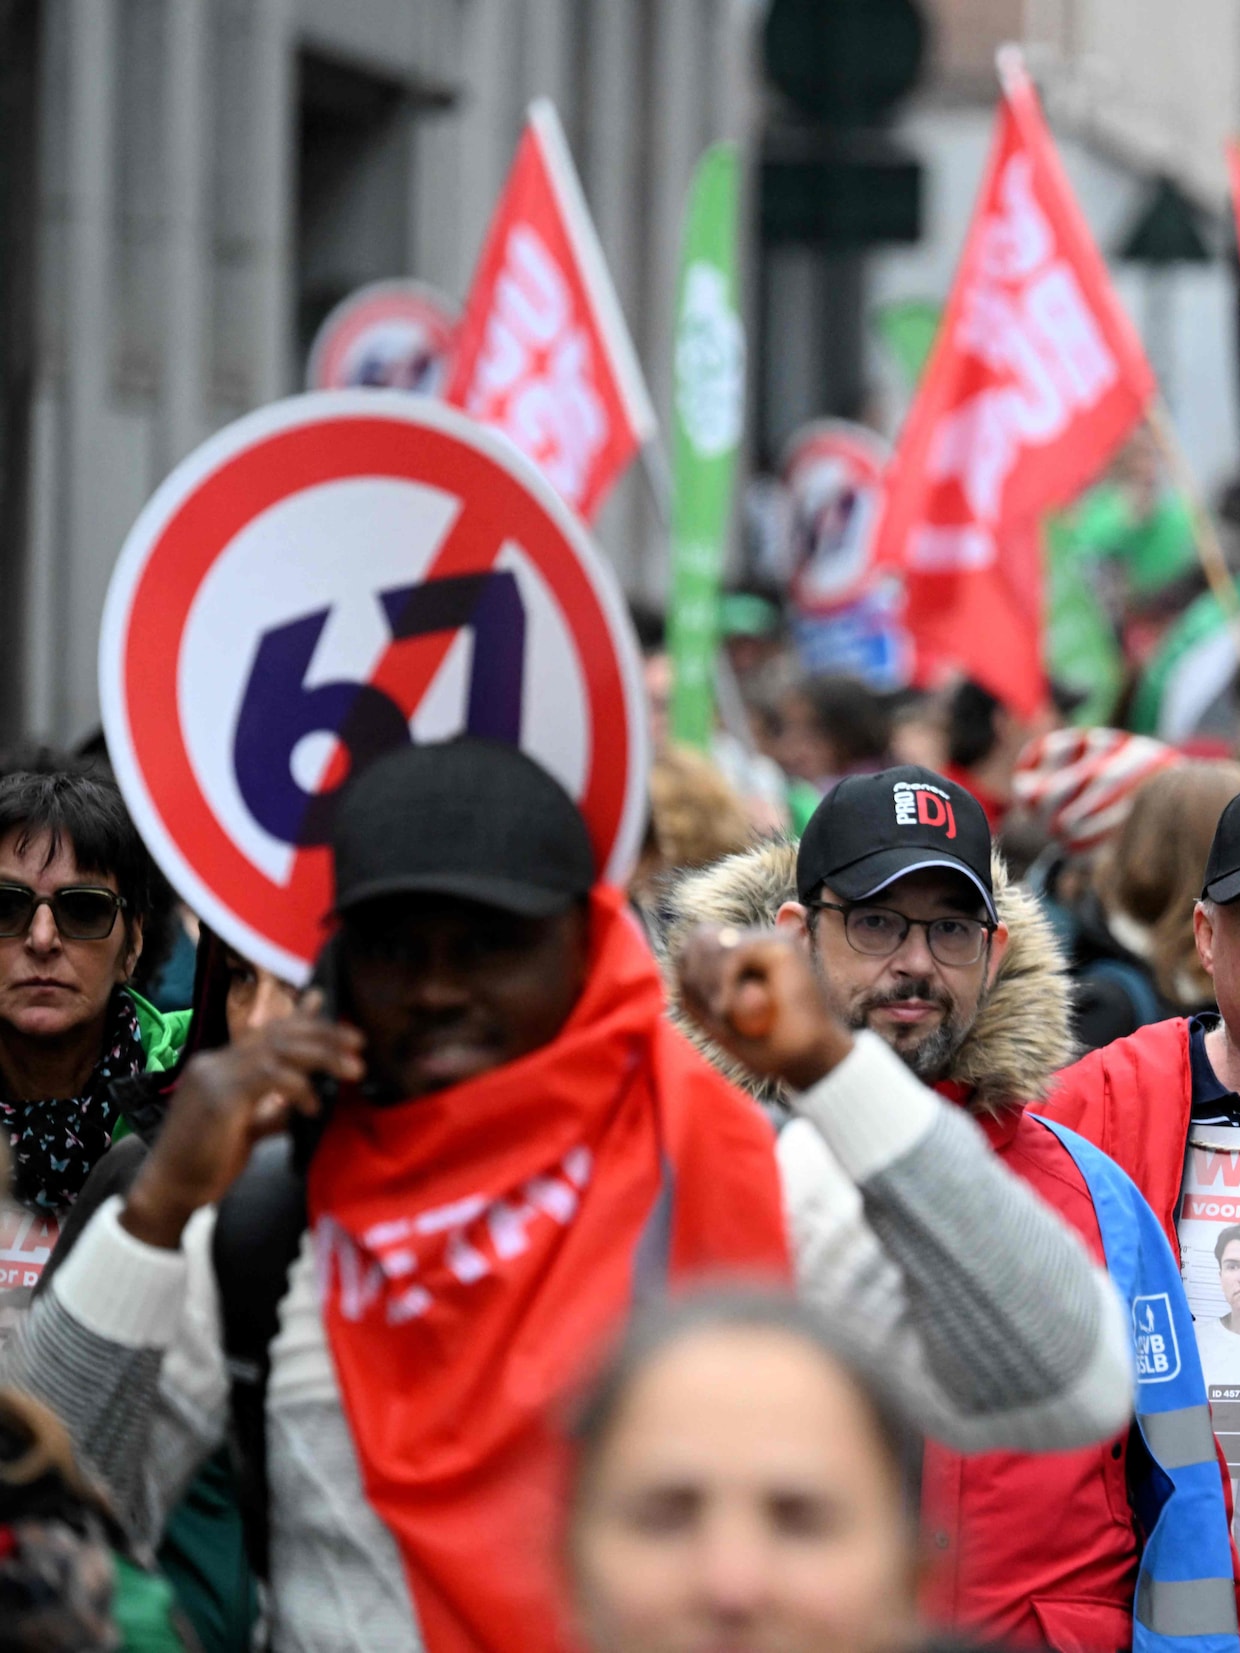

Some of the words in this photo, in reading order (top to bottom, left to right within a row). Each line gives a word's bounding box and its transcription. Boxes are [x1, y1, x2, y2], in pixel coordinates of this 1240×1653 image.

[231, 568, 526, 848] 67
[894, 791, 917, 824] PRO
[916, 790, 956, 839] DJ
